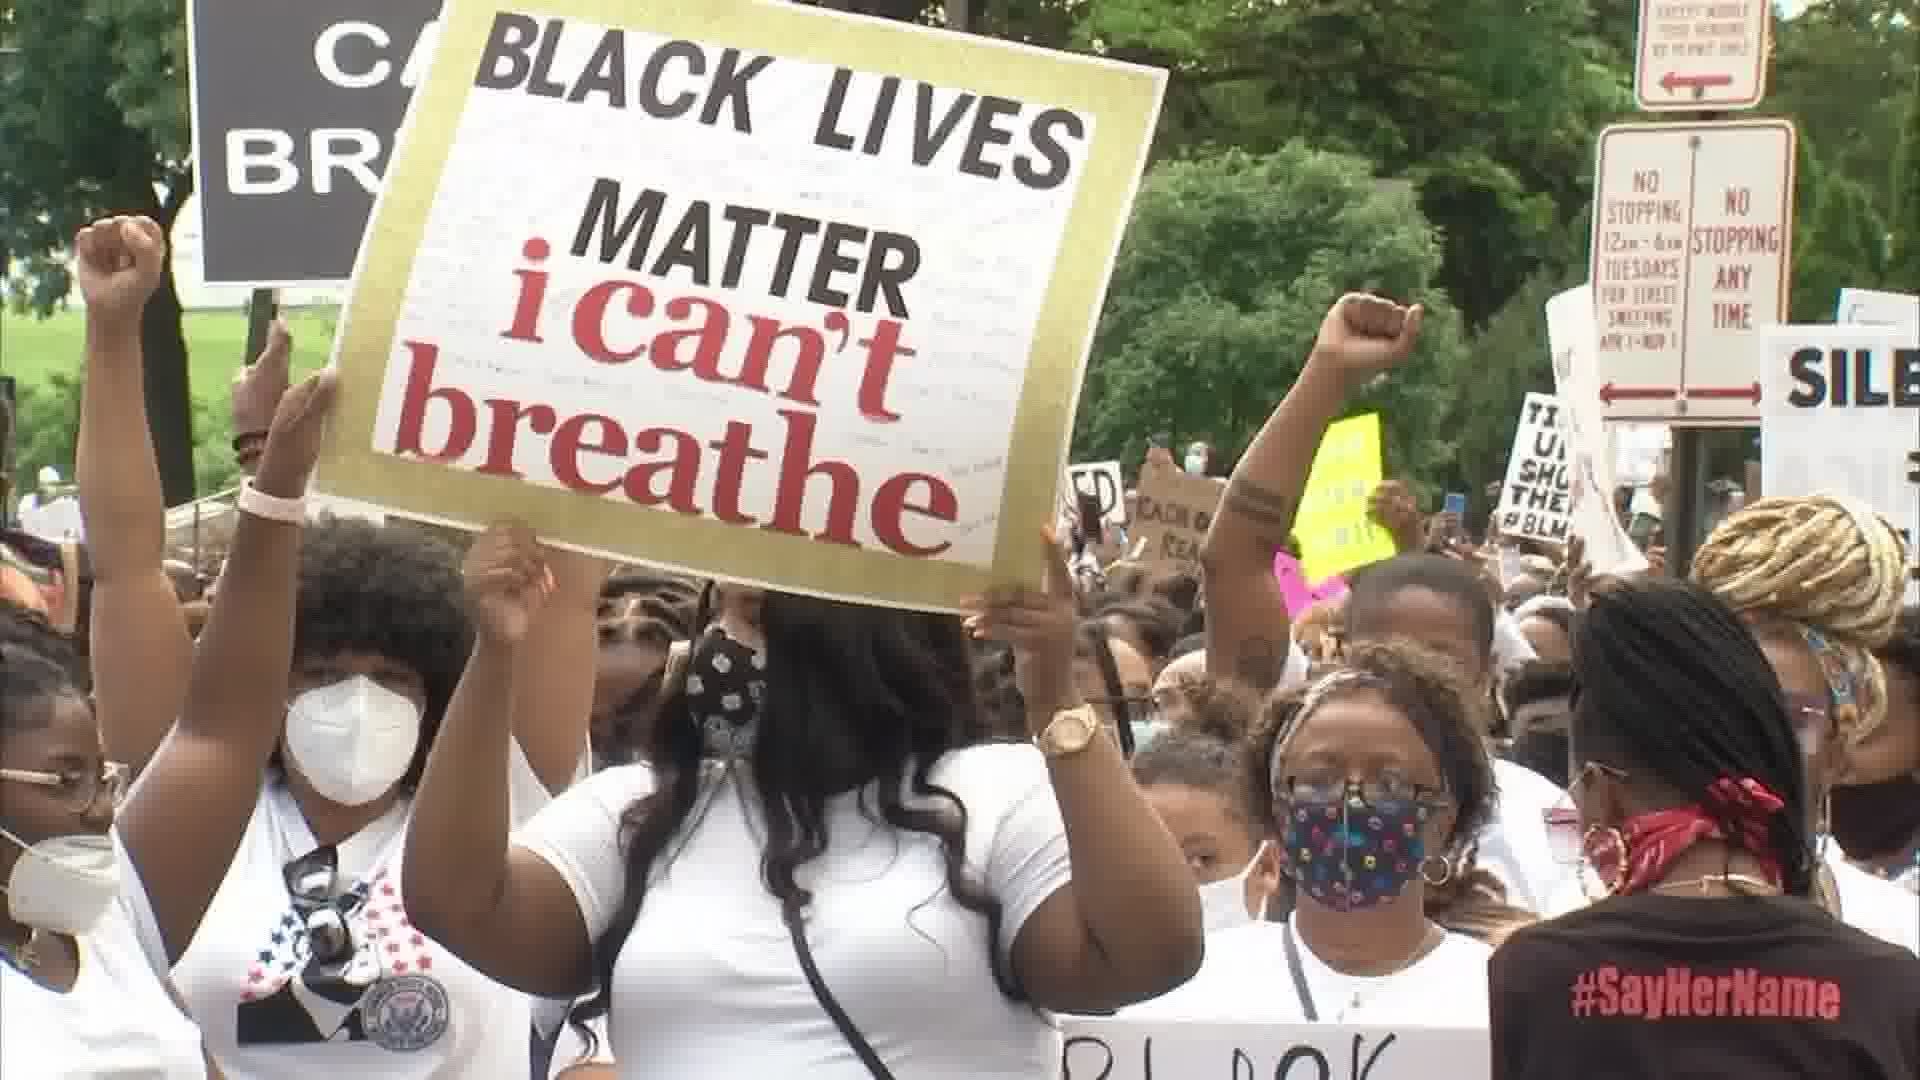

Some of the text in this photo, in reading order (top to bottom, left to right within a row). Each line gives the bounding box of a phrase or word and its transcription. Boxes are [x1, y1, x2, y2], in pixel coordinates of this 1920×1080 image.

[474, 11, 1085, 190] BLACK LIVES
[1633, 170, 1660, 194] NO
[1607, 200, 1681, 224] STOPPING
[1725, 188, 1750, 216] NO
[571, 177, 921, 319] MATTER
[1692, 225, 1778, 255] STOPPING
[1604, 258, 1680, 281] TUESDAYS
[1714, 264, 1752, 290] ANY
[500, 236, 917, 424] i can't
[1713, 303, 1752, 330] TIME
[395, 341, 958, 559] breathe
[1570, 961, 1841, 1020] #SayHerName
